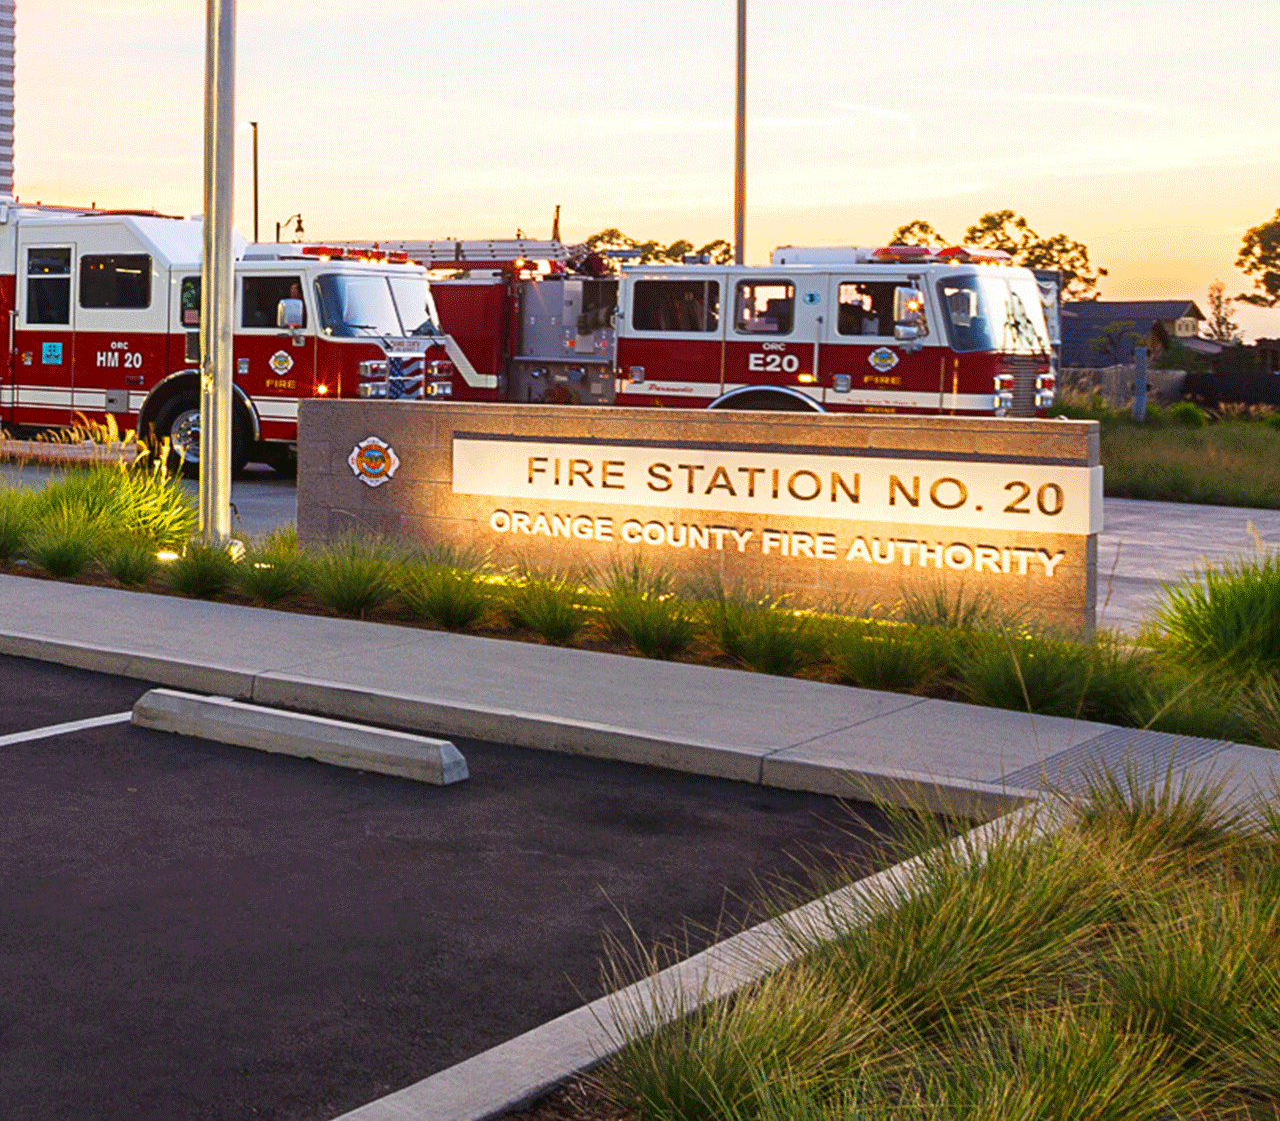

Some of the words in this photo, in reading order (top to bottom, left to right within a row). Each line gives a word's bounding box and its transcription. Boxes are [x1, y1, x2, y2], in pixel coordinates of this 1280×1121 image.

[110, 341, 128, 350] ORC
[762, 342, 786, 351] ORC
[96, 351, 119, 367] HM
[124, 352, 142, 368] 20
[749, 353, 799, 372] E20
[265, 379, 296, 389] FIRE
[863, 375, 901, 385] FIRE
[527, 456, 626, 490] FIRE
[647, 462, 860, 504] STATION
[889, 474, 983, 510] NO.
[1003, 480, 1065, 516] 20
[490, 508, 613, 541] ORANGE
[622, 519, 753, 553] COUNTY
[762, 528, 837, 560] FIRE
[845, 535, 1066, 577] AUTHORITY
